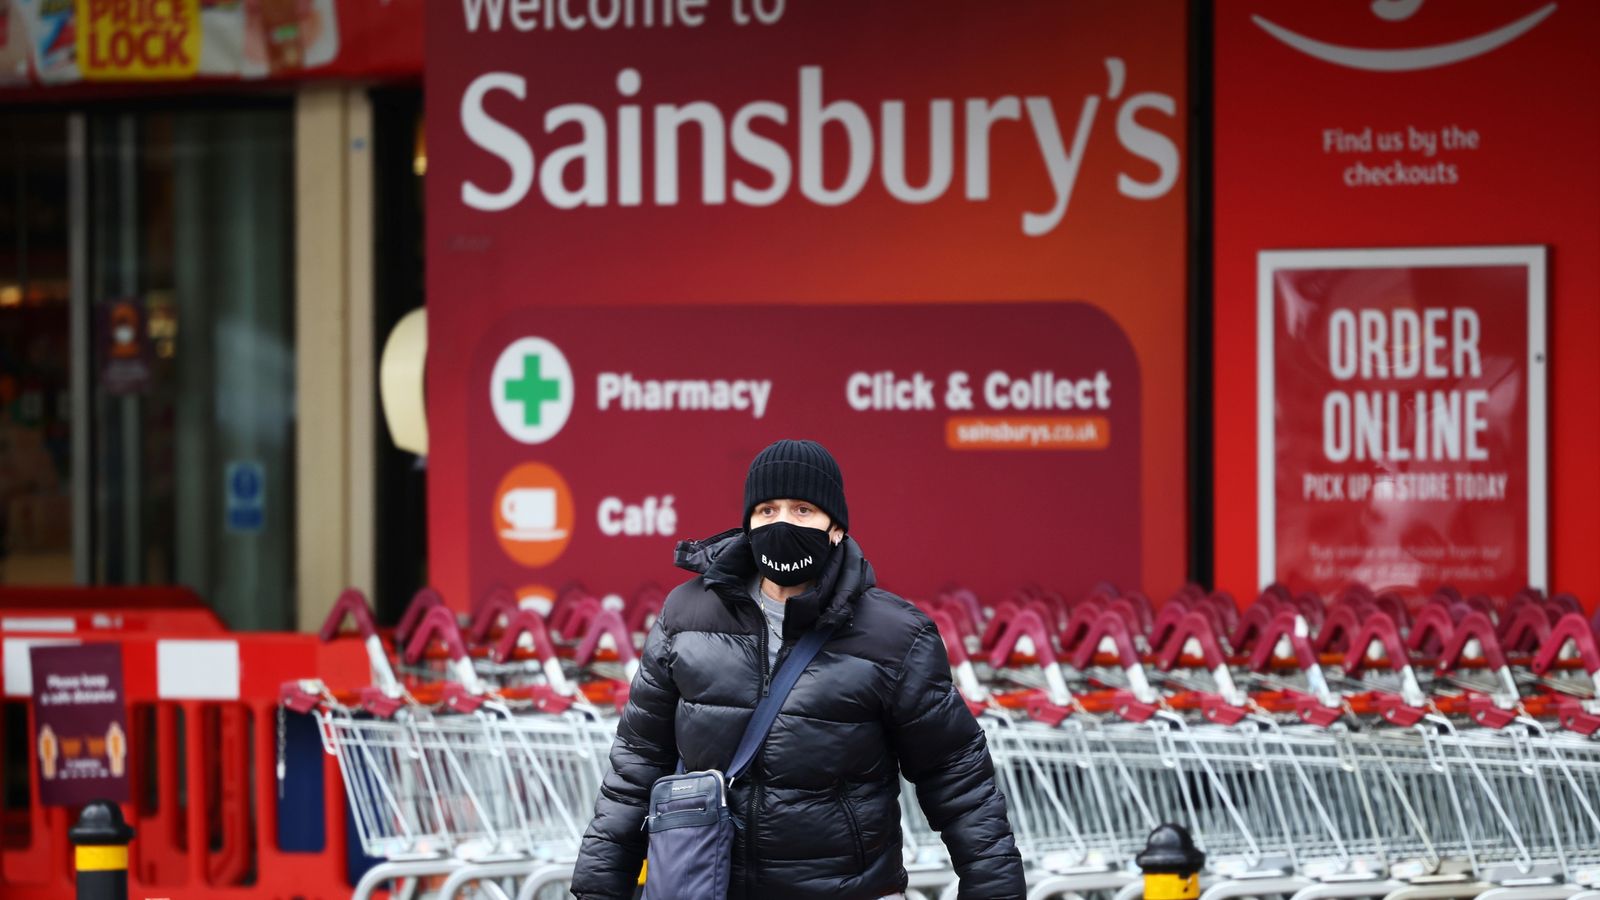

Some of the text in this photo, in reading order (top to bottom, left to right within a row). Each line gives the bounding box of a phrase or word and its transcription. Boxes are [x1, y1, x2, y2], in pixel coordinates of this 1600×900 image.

[731, 0, 786, 26] to
[89, 28, 191, 70] LOCK
[459, 57, 1181, 237] Sainsbury's
[1322, 125, 1480, 157] Find us by the
[1343, 160, 1459, 187] checkouts
[1328, 306, 1482, 381] ORDER
[596, 372, 772, 419] Pharmacy
[846, 370, 1111, 411] Click & Collect
[956, 420, 1098, 446] sainsburys.co.uk
[1322, 389, 1490, 463] ONLINE
[1303, 474, 1345, 501] PICK
[1349, 474, 1372, 501] UP
[1396, 473, 1450, 501] STORE
[1455, 473, 1509, 501] TODAY
[596, 494, 678, 537] Café
[761, 554, 813, 573] BALMAIN
